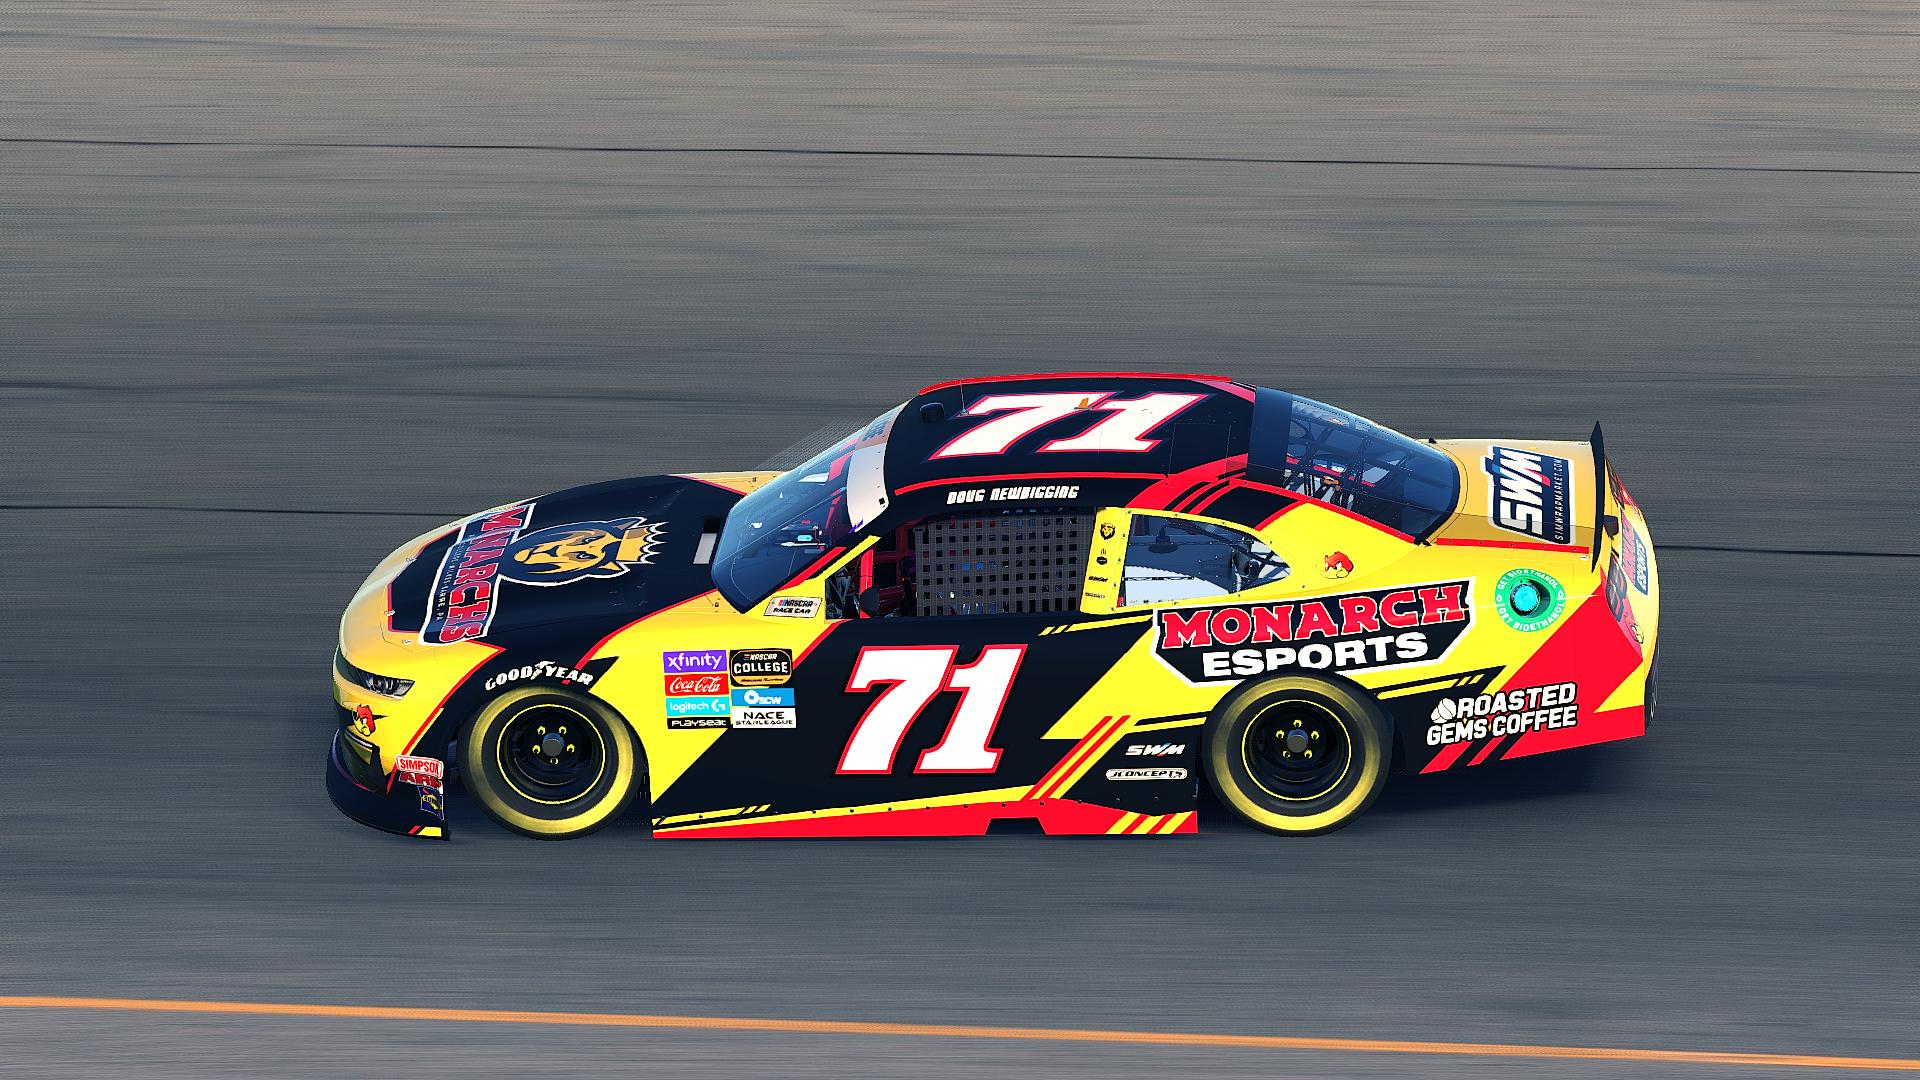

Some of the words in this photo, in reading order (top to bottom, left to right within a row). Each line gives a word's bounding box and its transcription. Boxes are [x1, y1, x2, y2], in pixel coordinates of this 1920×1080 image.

[928, 391, 1209, 460] 71
[946, 489, 986, 505] DOUG
[989, 486, 1080, 501] NEWBIGGING
[1492, 448, 1550, 536] SWM
[1497, 577, 1509, 590] GET
[783, 599, 814, 607] NASCAR
[1161, 584, 1466, 649] MONARCH
[667, 652, 723, 670] xfinity
[1202, 632, 1429, 678] ESPORTS
[484, 661, 594, 691] GOODYEAR
[733, 661, 789, 674] COLLEGE
[669, 676, 723, 693] Coca-Cola
[669, 701, 710, 713] logitech
[835, 643, 1028, 775] 71
[1457, 683, 1577, 718] ROASTED
[743, 711, 785, 720] NACE
[1426, 718, 1488, 746] GEMS
[1492, 705, 1578, 737] COFFEE
[1125, 743, 1186, 757] SWM
[400, 758, 440, 776] SIMPSON
